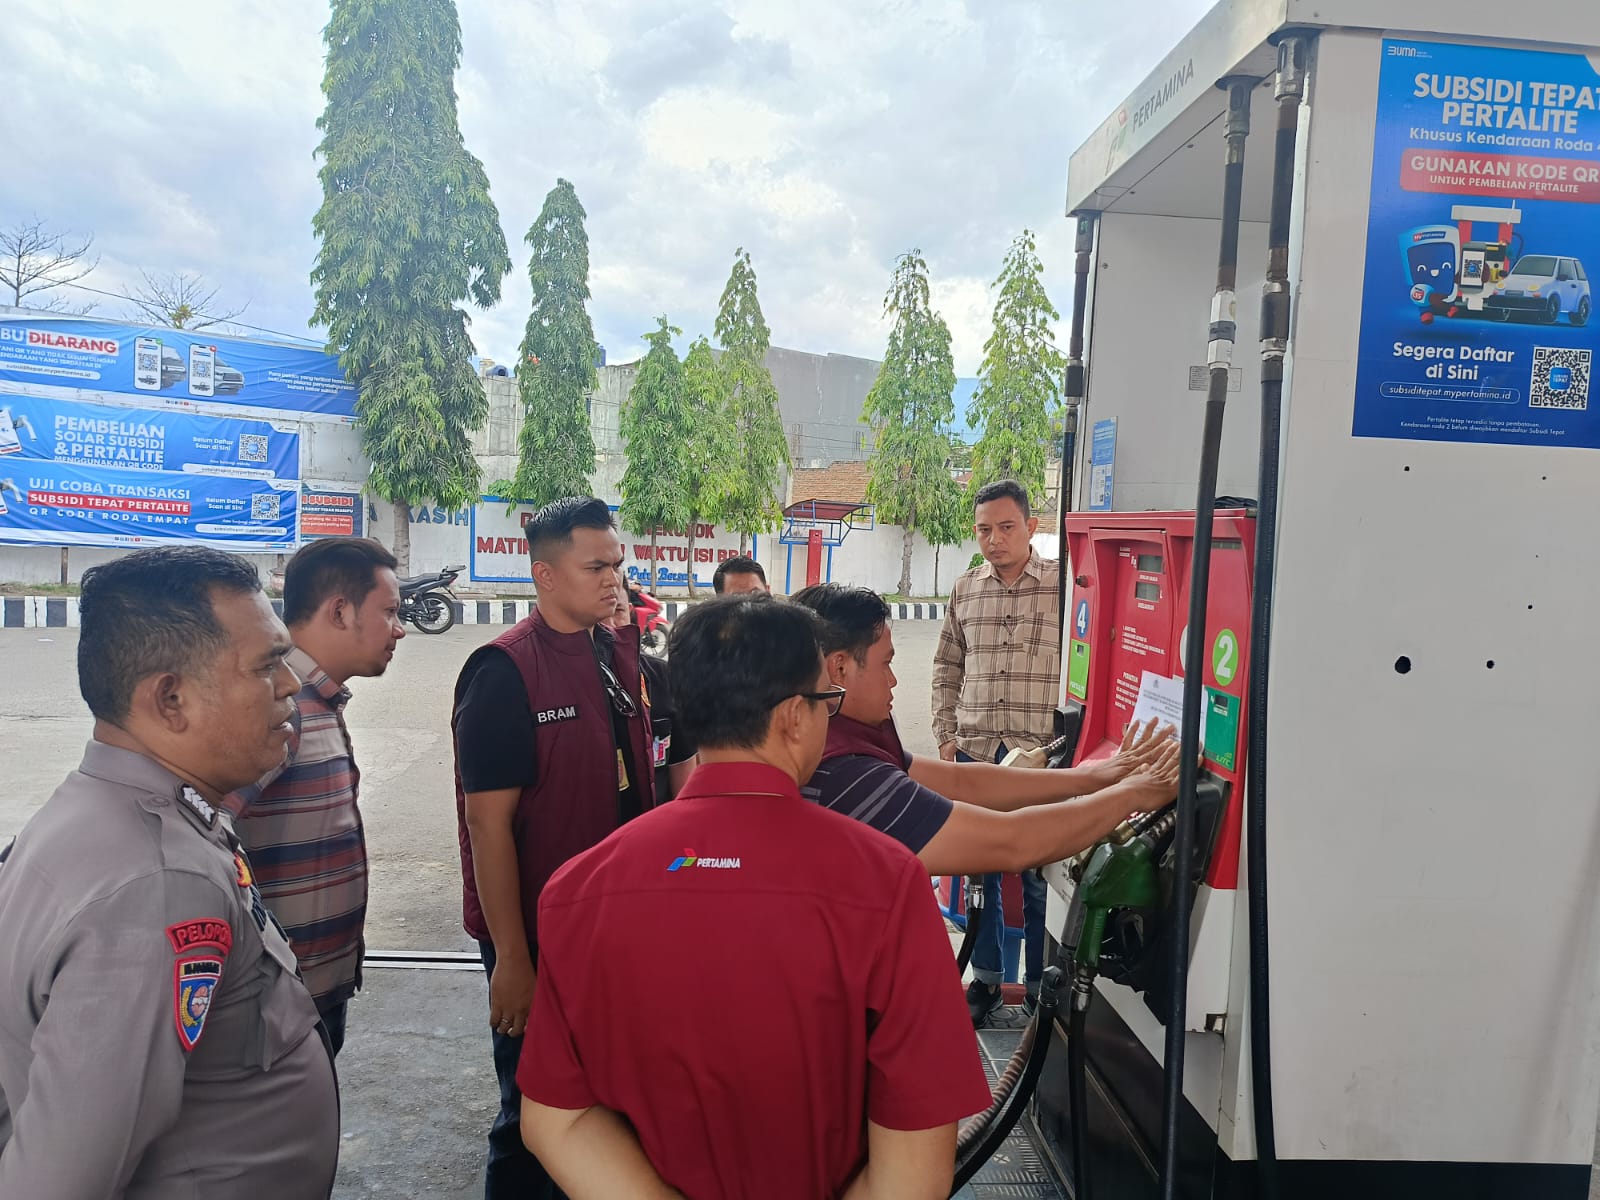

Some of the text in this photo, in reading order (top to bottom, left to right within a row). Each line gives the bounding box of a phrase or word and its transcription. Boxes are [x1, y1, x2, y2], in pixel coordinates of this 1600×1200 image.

[1132, 58, 1194, 133] PERTAMINA
[1413, 72, 1522, 104] SUBSIDI
[1442, 101, 1578, 134] PERTALITE
[1409, 127, 1593, 152] Khusus Kendaraan Roda
[1411, 155, 1599, 184] GUNAKAN KODE QR
[1429, 175, 1579, 193] UNTUK PEMBELIAN PERTALITE
[29, 331, 117, 353] DILARANG
[1393, 341, 1515, 363] Segera Daftar
[1425, 362, 1479, 380] di Sini
[1389, 386, 1512, 400] subsiditepat.mypertamina.id
[54, 415, 165, 440] PEMBELIAN
[55, 430, 164, 450] SOLAR SUBSIDI
[54, 441, 164, 463] & PERTALITE
[29, 477, 190, 500] UJI COBA TRANSAKSI
[30, 494, 189, 512] SUBSIDI TEPAT PERTALITE
[309, 495, 354, 506] SUBSIDI
[29, 507, 189, 525] QR CODE RODA EMPAT
[694, 547, 714, 563] ISI
[1077, 603, 1086, 634] 4
[1216, 635, 1233, 678] 2
[537, 705, 576, 723] BRAM
[696, 858, 741, 869] PERTAMINA
[176, 923, 227, 946] PELOPO
